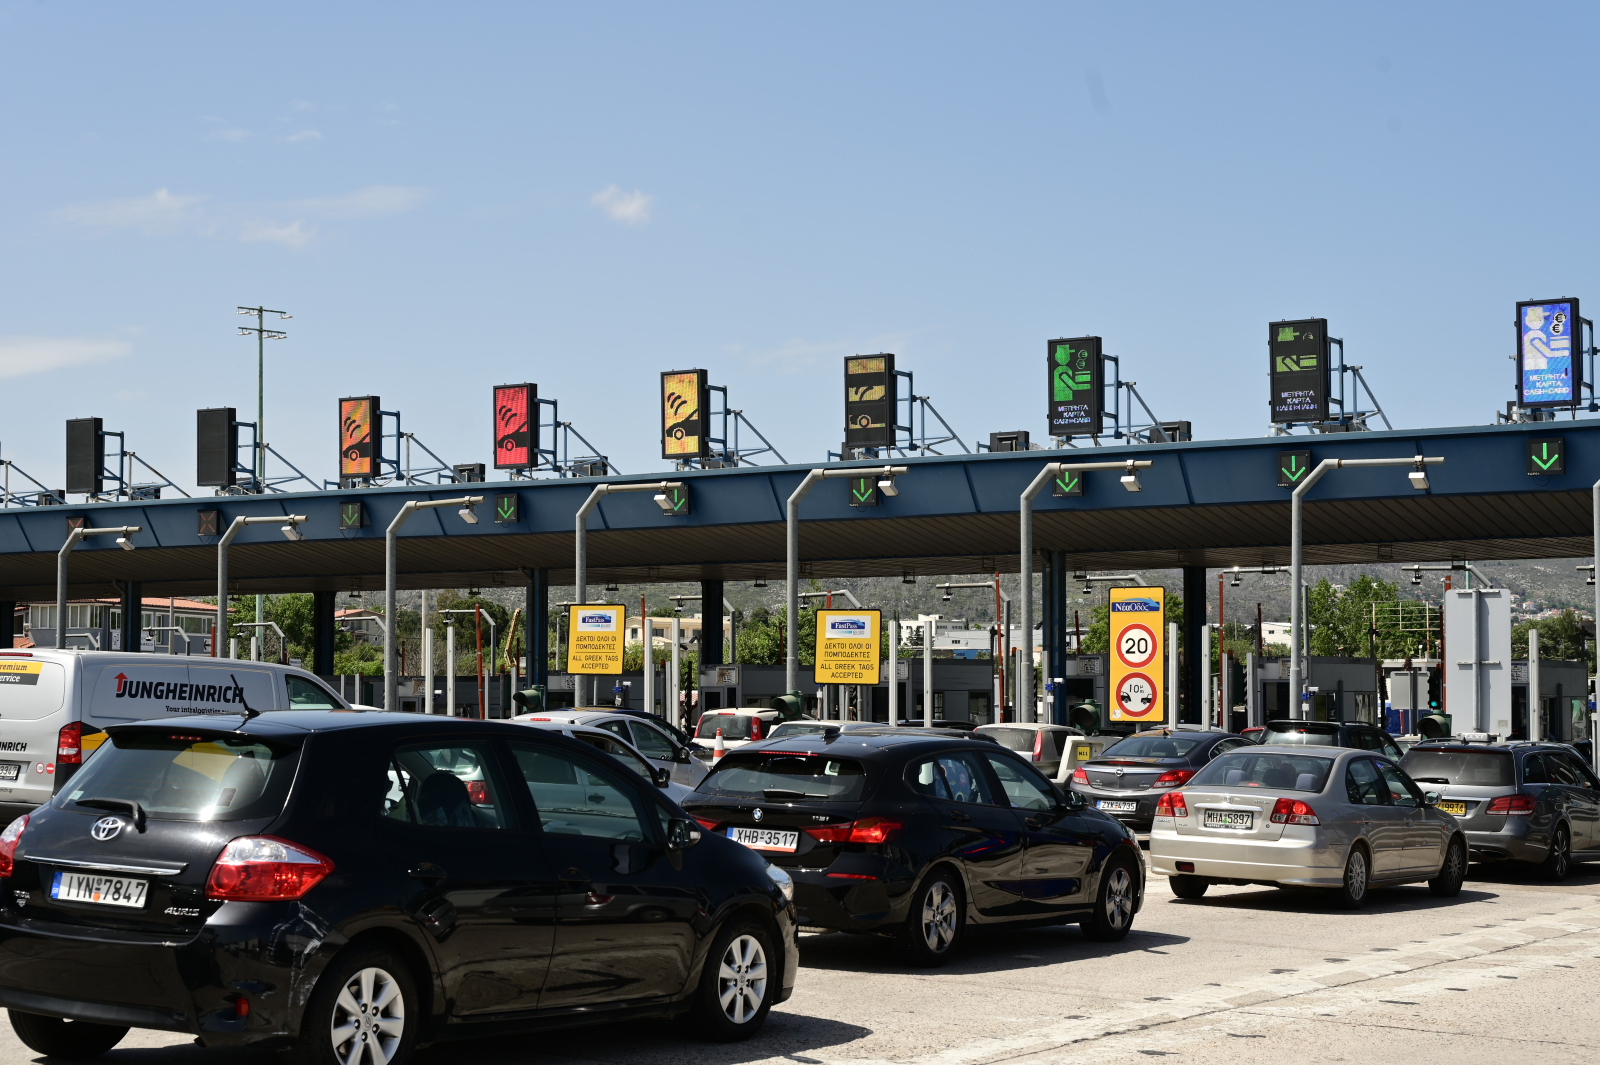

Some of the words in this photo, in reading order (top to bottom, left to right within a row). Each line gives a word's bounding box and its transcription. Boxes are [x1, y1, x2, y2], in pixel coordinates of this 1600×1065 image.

[1126, 638, 1148, 654] 20
[116, 680, 244, 703] JUNGHEINRICH
[1130, 684, 1139, 693] 10
